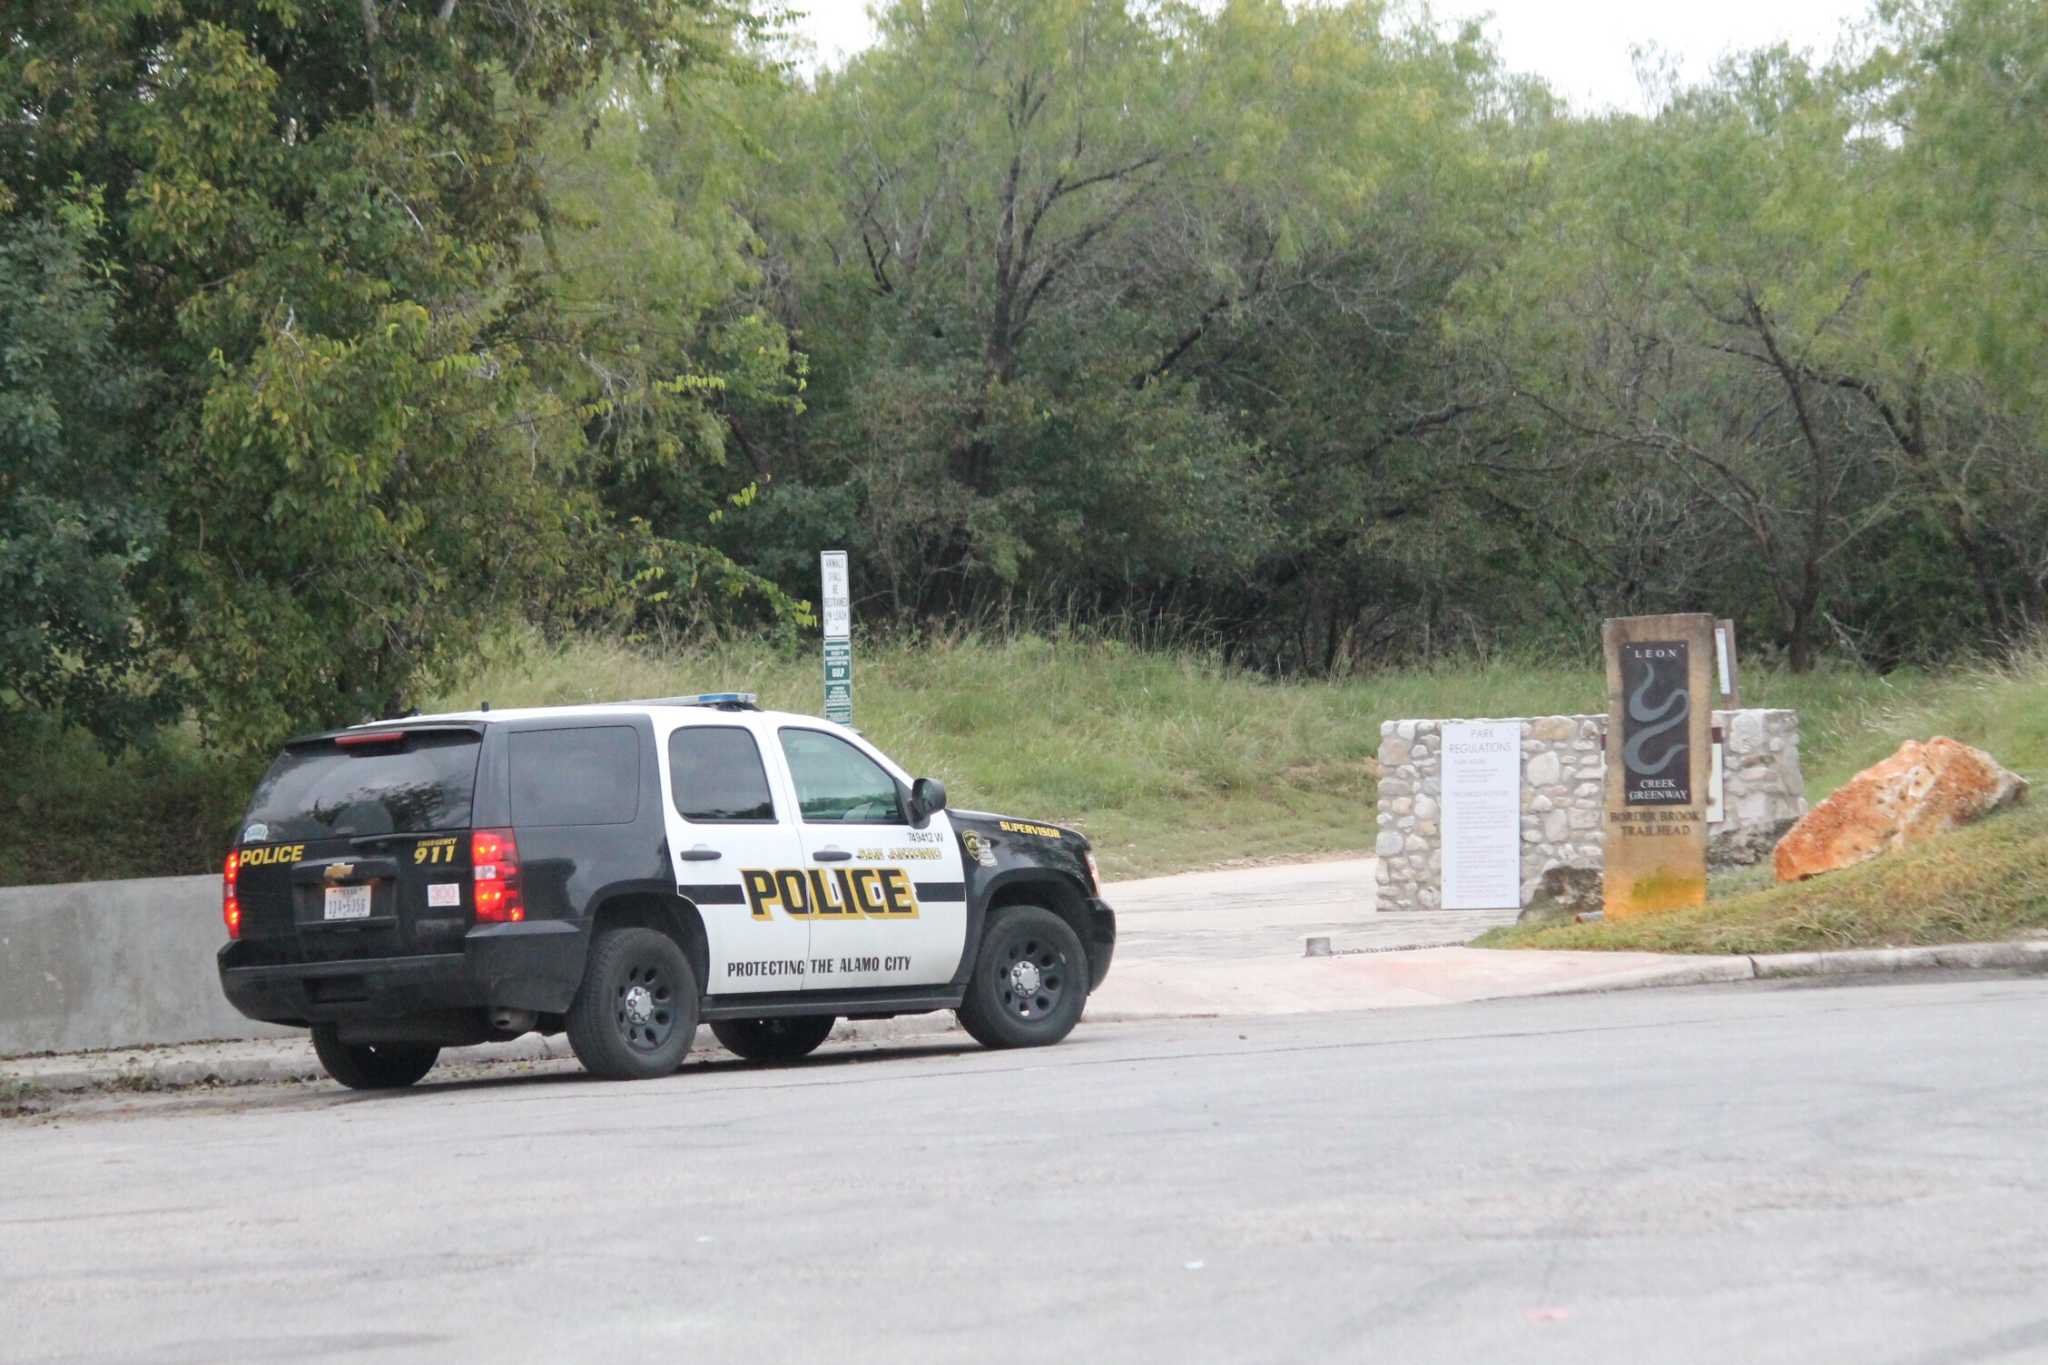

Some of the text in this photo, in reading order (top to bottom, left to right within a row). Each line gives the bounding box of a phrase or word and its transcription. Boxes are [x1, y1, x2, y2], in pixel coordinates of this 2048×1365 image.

[1634, 648, 1677, 658] LEON
[1471, 728, 1495, 738] PARK
[1448, 742, 1512, 753] REGULATIONS
[1640, 778, 1677, 789] CREEK
[1628, 790, 1688, 801] GREENWAY
[999, 821, 1062, 838] SUPERVISOR
[239, 845, 305, 868] POLICE
[414, 845, 455, 865] 911
[739, 868, 919, 921] POLICE
[727, 955, 911, 977] PROTECTING THE ALAMO CITY
